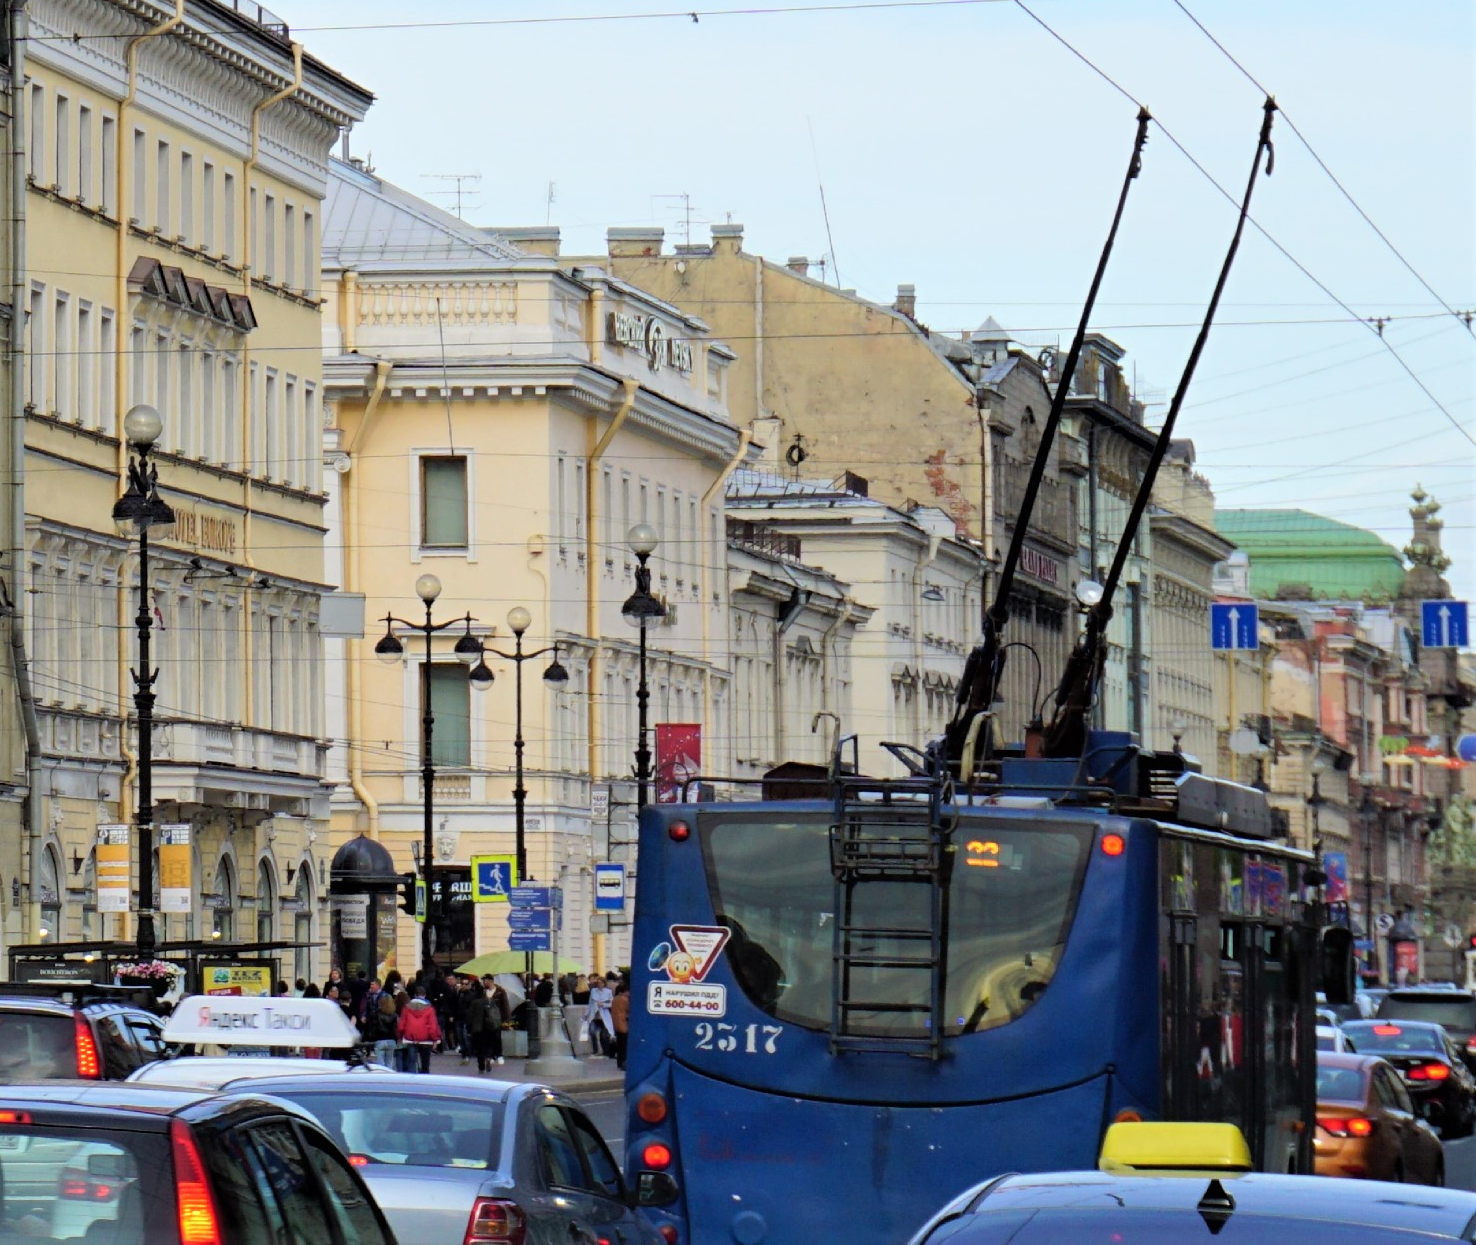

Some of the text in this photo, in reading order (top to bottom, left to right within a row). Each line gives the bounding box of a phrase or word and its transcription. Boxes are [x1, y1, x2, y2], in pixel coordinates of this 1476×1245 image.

[653, 986, 662, 997] Я
[665, 999, 719, 1010] 600-44-00
[198, 1006, 312, 1030] Яндекс Такси
[695, 1022, 784, 1054] 2517
